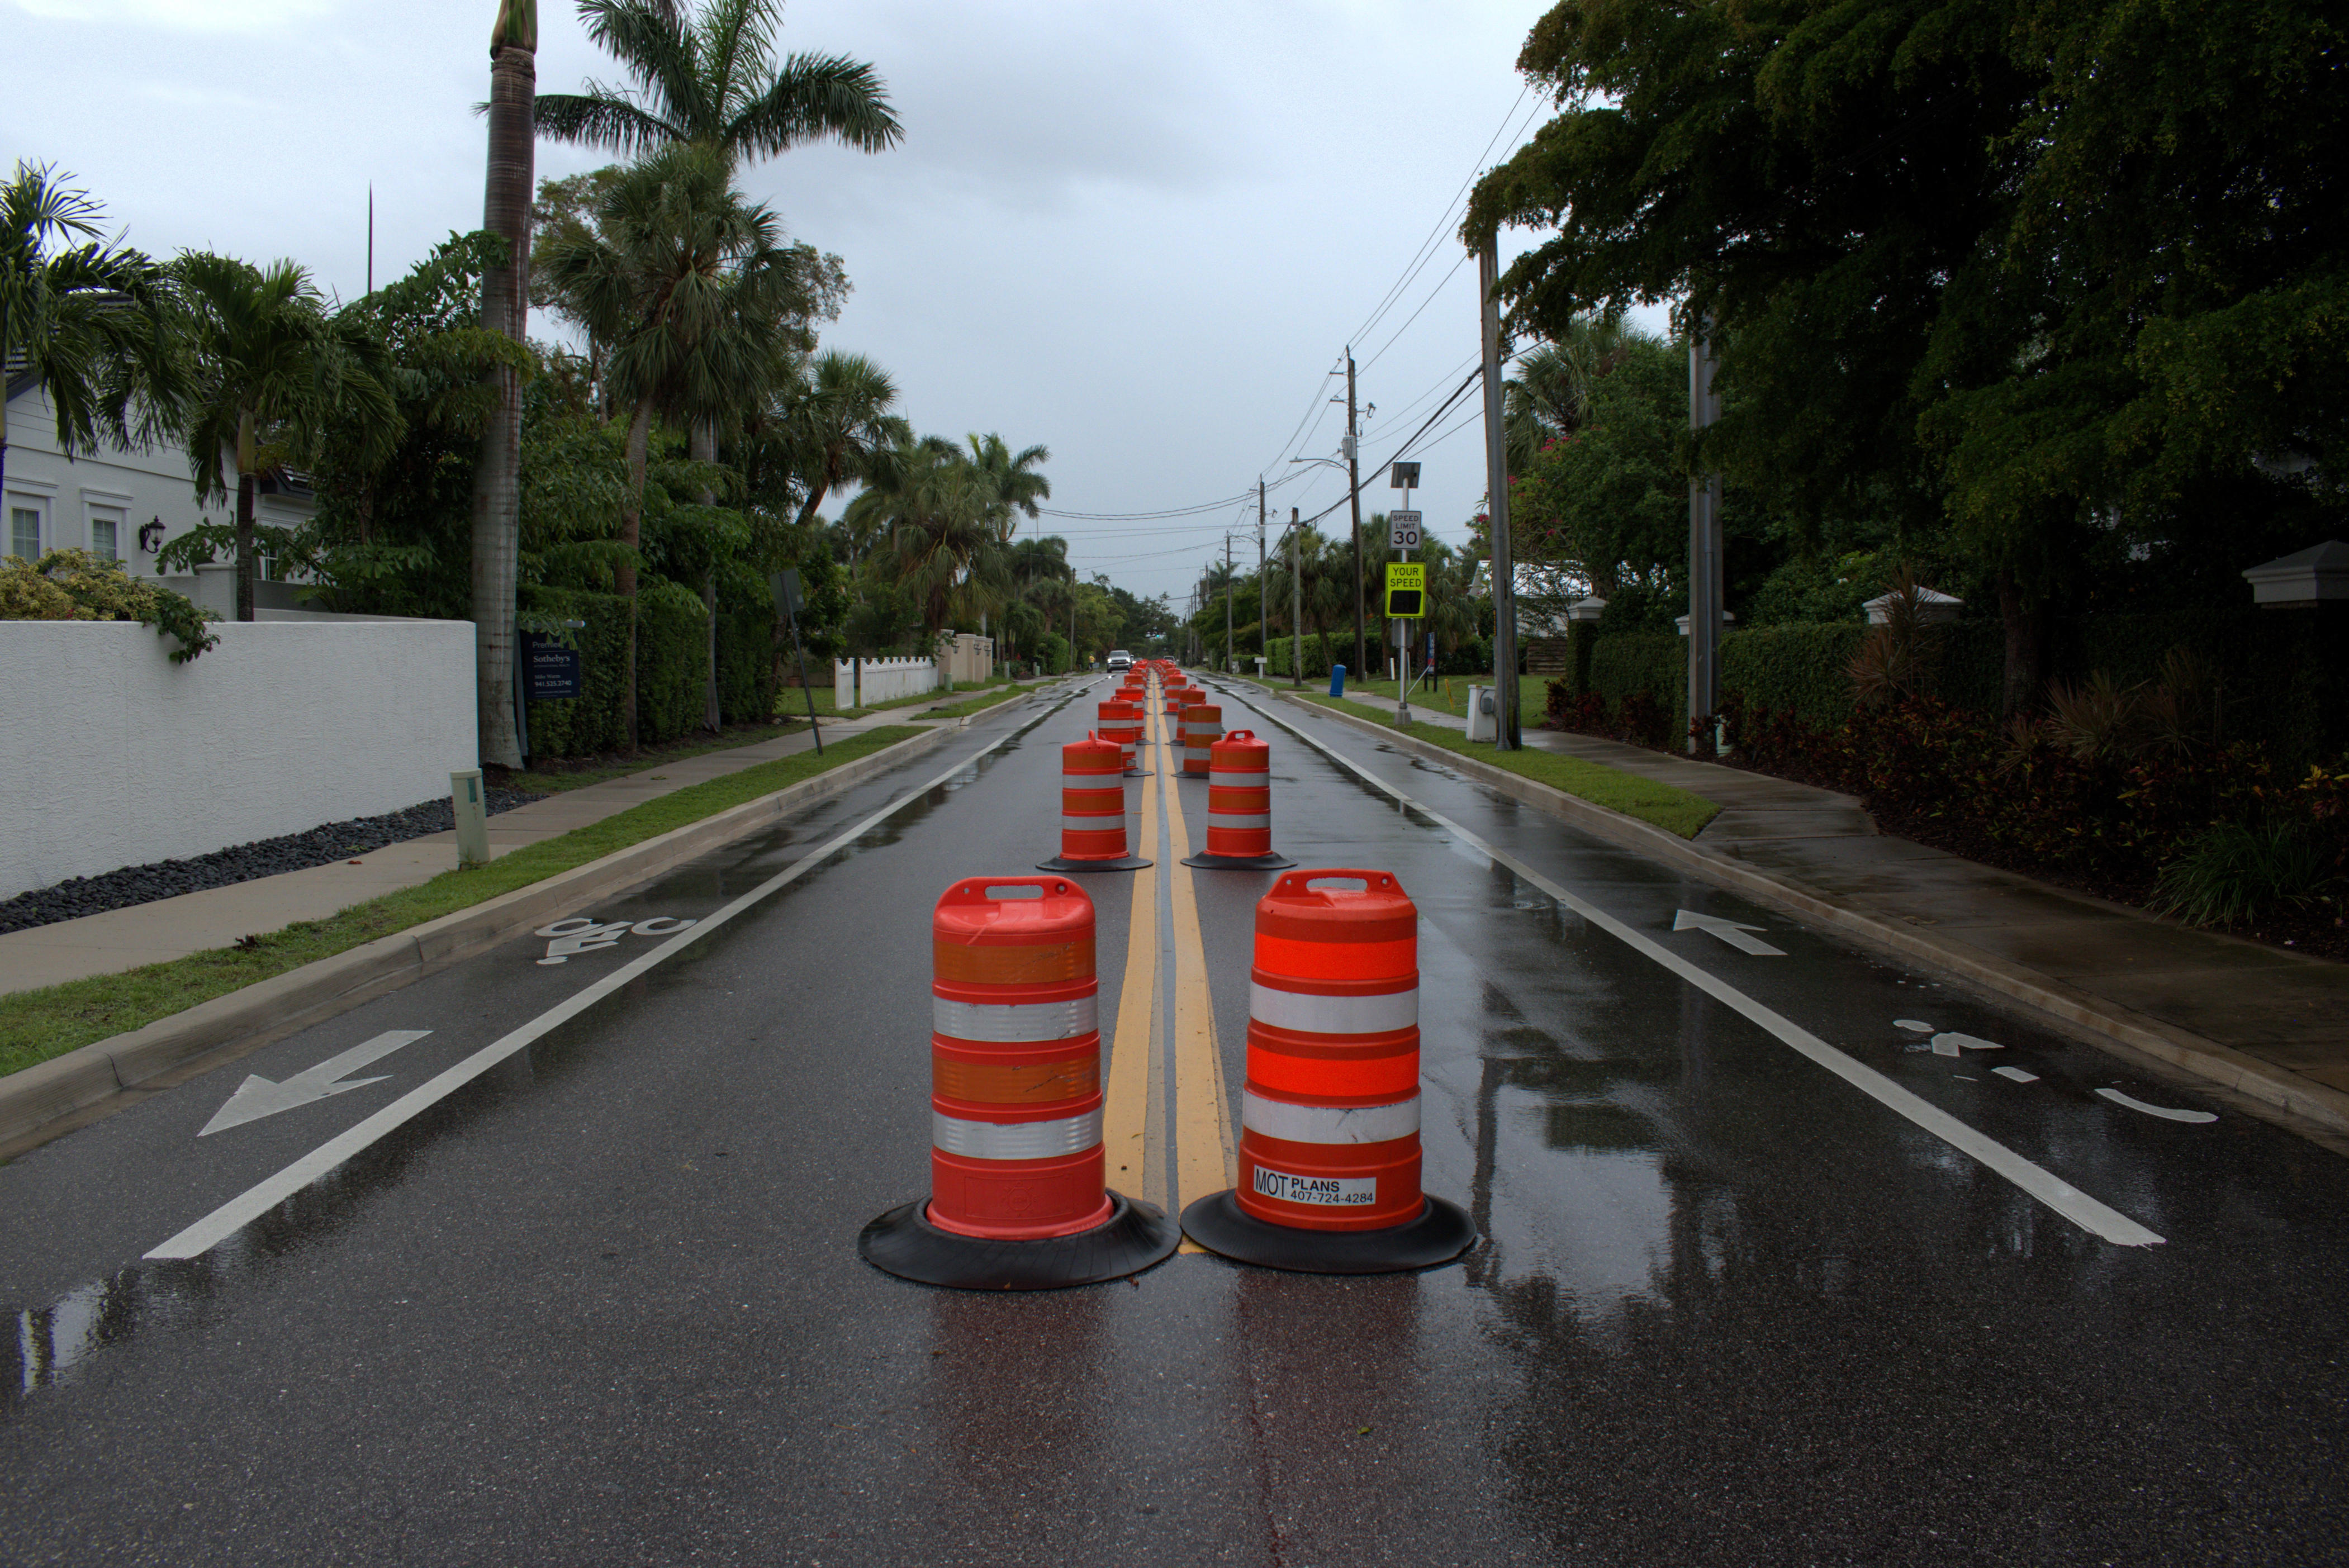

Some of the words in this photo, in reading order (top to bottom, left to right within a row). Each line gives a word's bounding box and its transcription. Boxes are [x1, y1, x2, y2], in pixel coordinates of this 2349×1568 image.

[1394, 531, 1417, 544] 30
[1393, 567, 1418, 576] YOUR
[1391, 578, 1421, 587] SPEED
[533, 654, 570, 663] Sotheby's
[1256, 1169, 1288, 1197] MOT
[1292, 1178, 1340, 1192] PLANS
[1291, 1190, 1373, 1203] 407-724-4284
